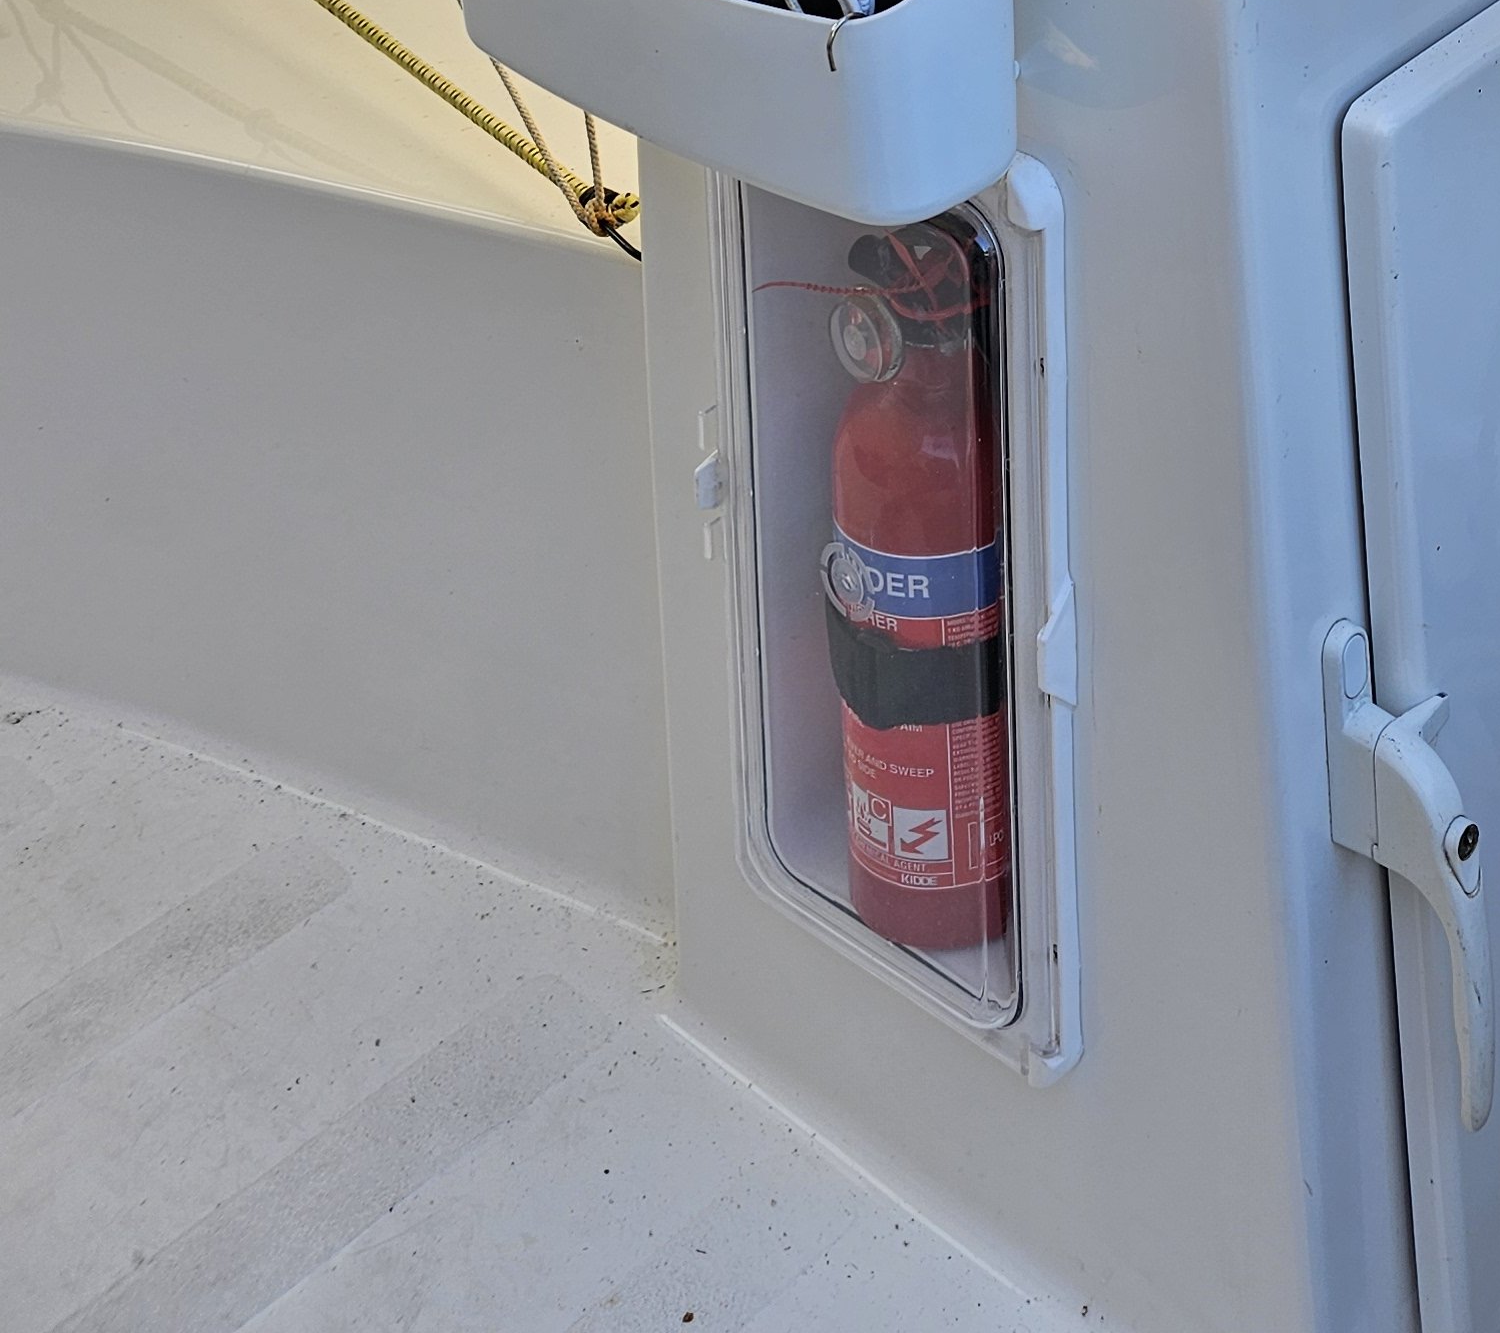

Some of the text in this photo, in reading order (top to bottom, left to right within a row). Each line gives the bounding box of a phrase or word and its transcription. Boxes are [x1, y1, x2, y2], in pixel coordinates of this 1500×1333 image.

[865, 566, 930, 599] DER
[890, 764, 934, 778] SWEEP
[871, 797, 886, 820] C
[894, 859, 926, 872] AGENT
[901, 873, 938, 886] KIDDE
